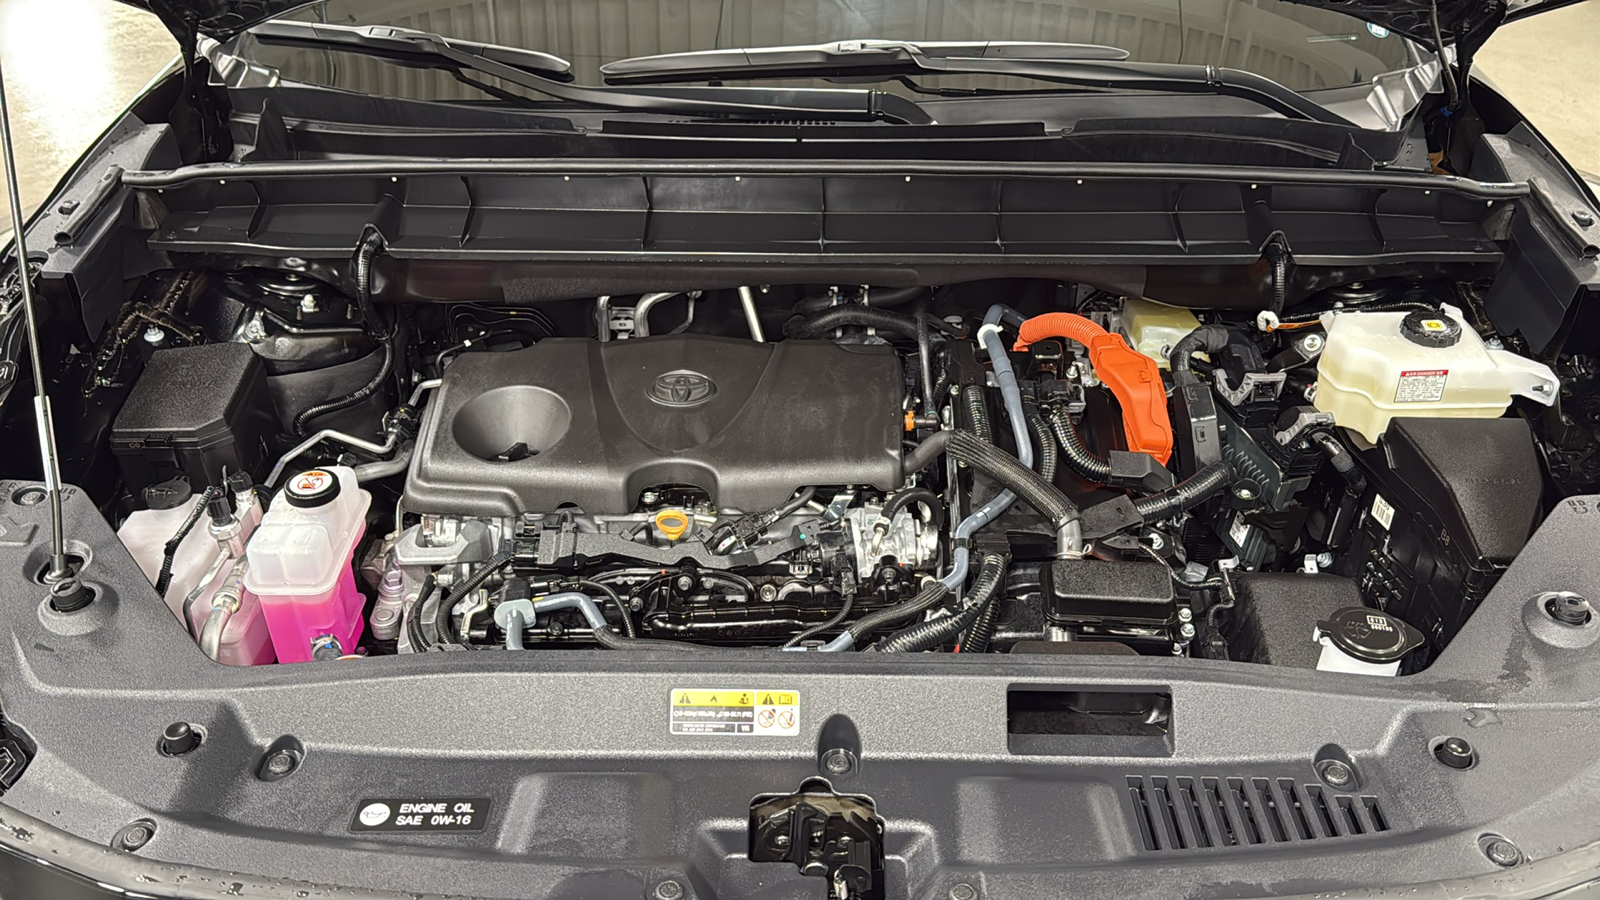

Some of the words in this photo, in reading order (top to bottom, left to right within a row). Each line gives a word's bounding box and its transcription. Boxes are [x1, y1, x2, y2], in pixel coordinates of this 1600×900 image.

[399, 803, 448, 813] ENGINE
[453, 803, 475, 813] OIL
[395, 815, 424, 826] SAE
[430, 815, 472, 826] 0W-16
